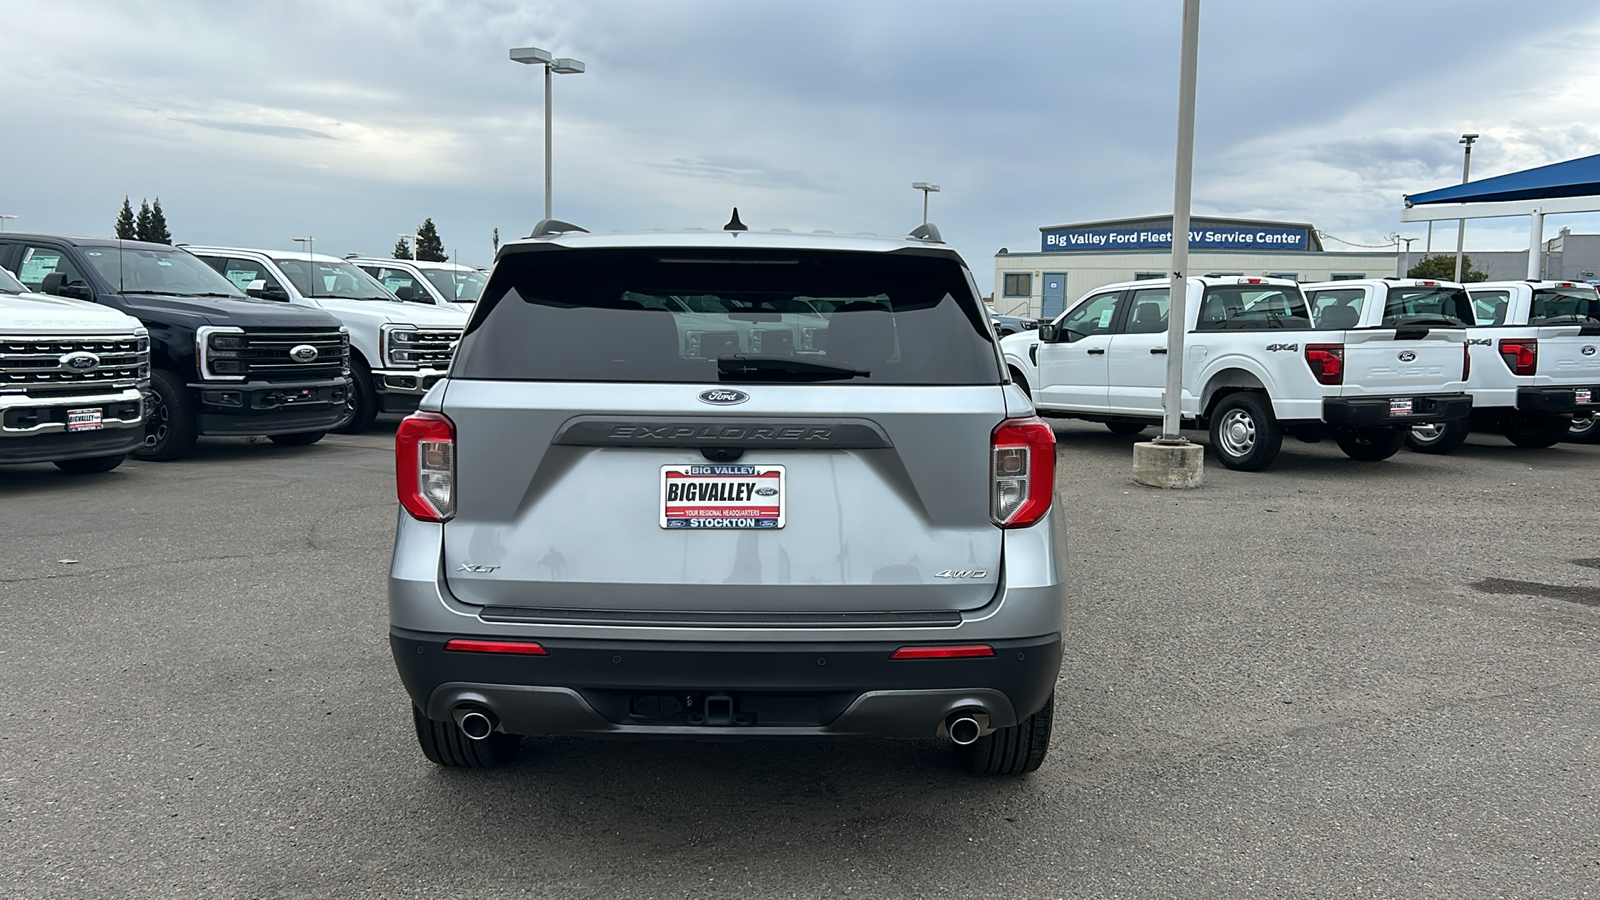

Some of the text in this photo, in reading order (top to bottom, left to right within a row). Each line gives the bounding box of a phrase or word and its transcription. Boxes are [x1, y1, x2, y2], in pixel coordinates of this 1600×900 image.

[1047, 234, 1067, 247] Big
[1069, 233, 1107, 246] Valley
[1109, 232, 1138, 244] Ford
[1140, 231, 1172, 243] Fleet
[1205, 231, 1254, 243] Service
[1256, 232, 1301, 244] Center
[73, 357, 93, 368] Ford
[708, 391, 738, 401] Ford
[608, 425, 833, 441] EXPLORER
[691, 466, 755, 475] BIG VALLEY
[667, 482, 757, 502] BIGVALLEY
[685, 509, 760, 517] YOUR REGIONAL HEADQUARTERS
[690, 518, 755, 528] STOCKTON
[456, 563, 501, 573] XLT
[934, 569, 988, 579] 4WD
